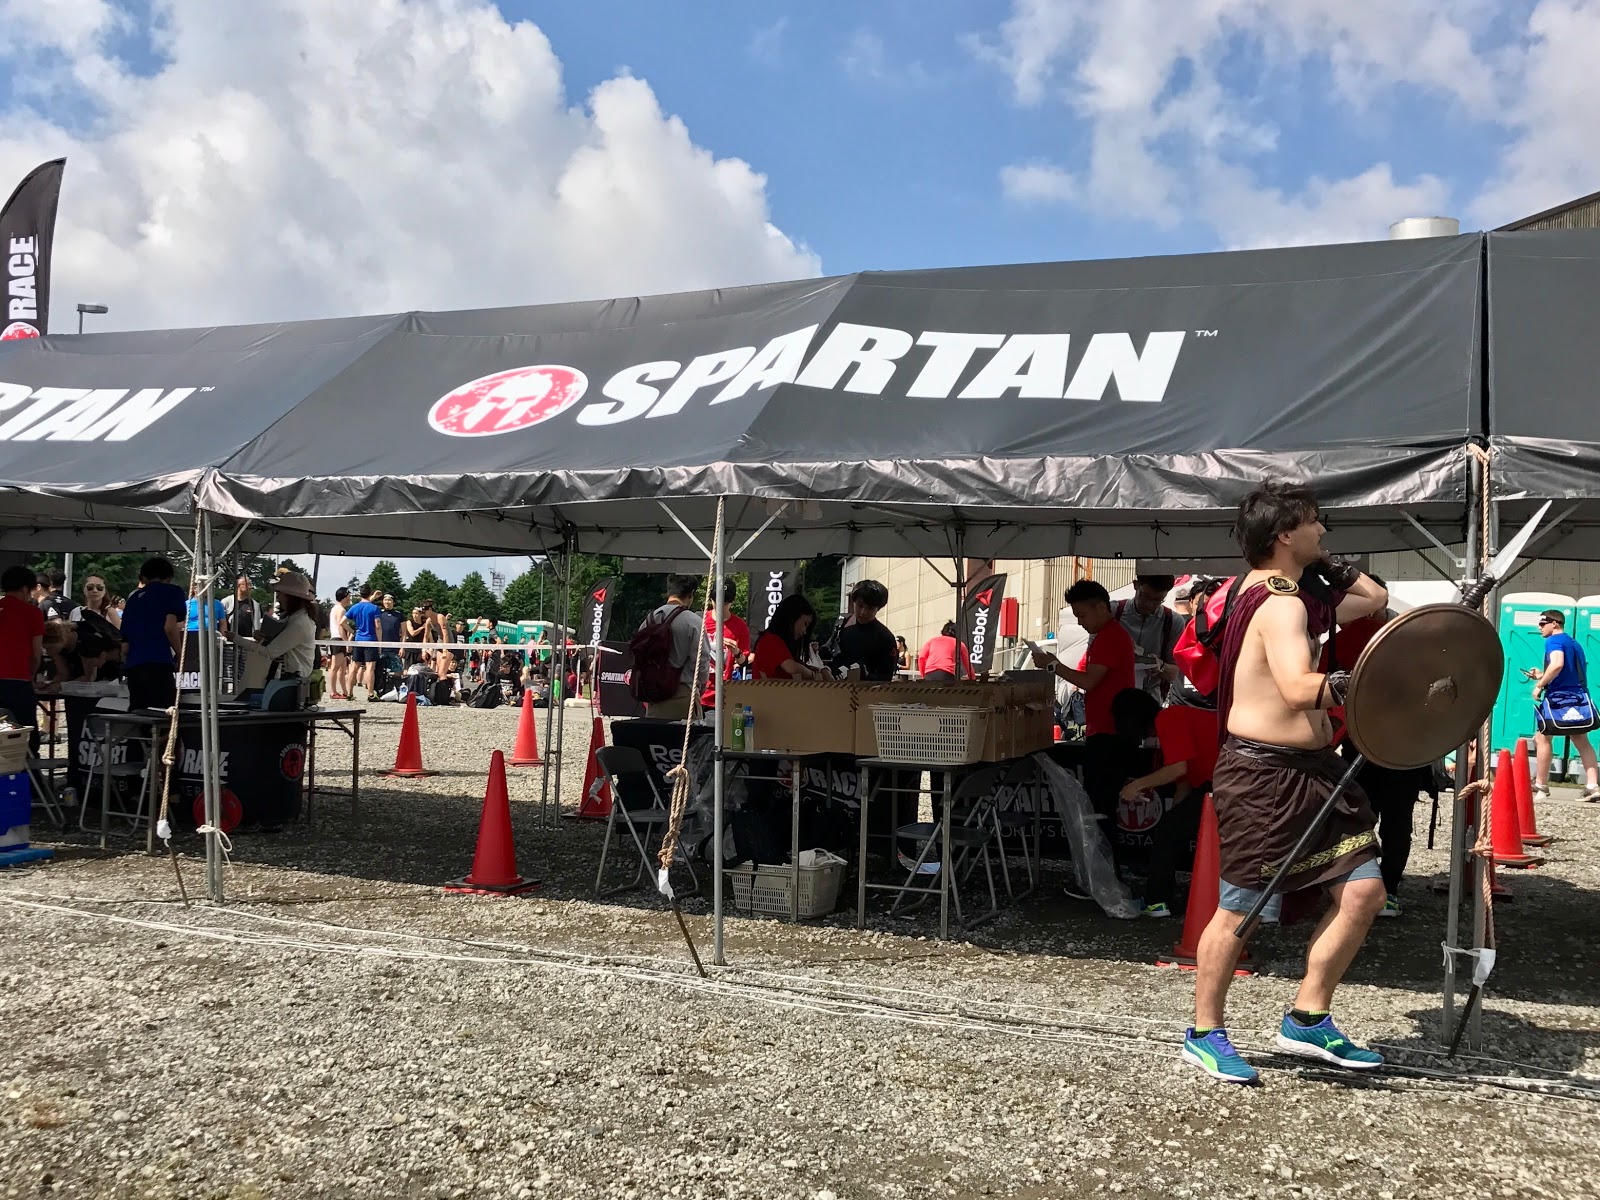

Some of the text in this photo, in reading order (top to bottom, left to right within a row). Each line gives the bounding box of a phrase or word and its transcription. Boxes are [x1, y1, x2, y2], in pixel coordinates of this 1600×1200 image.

[9, 235, 37, 319] RACE
[577, 322, 1186, 425] SPARTAN
[590, 603, 604, 647] Reebok
[970, 606, 990, 665] Reebok
[175, 672, 201, 687] RAC
[601, 671, 625, 682] SPARTAN
